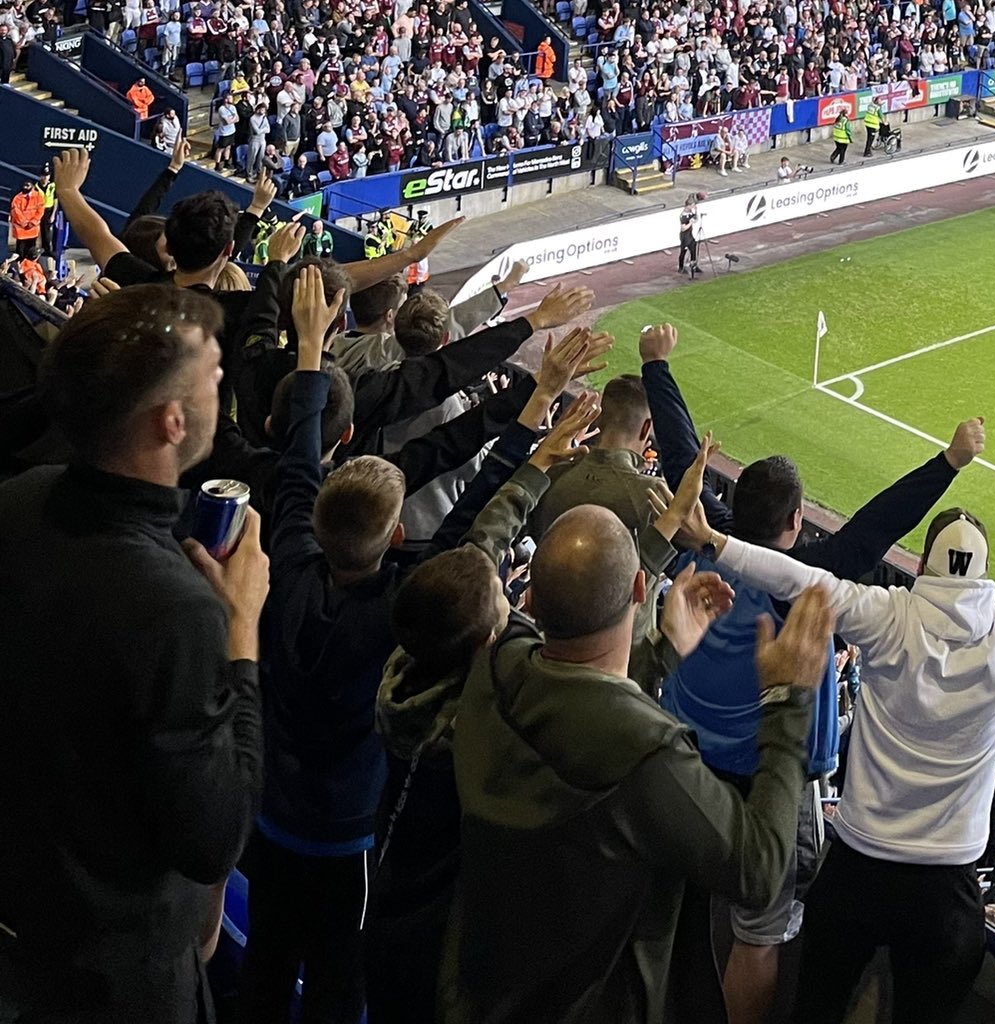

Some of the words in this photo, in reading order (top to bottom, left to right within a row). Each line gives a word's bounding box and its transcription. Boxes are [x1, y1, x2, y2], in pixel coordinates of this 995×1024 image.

[44, 127, 76, 140] FIRST
[78, 129, 98, 142] AID
[948, 548, 973, 576] W
